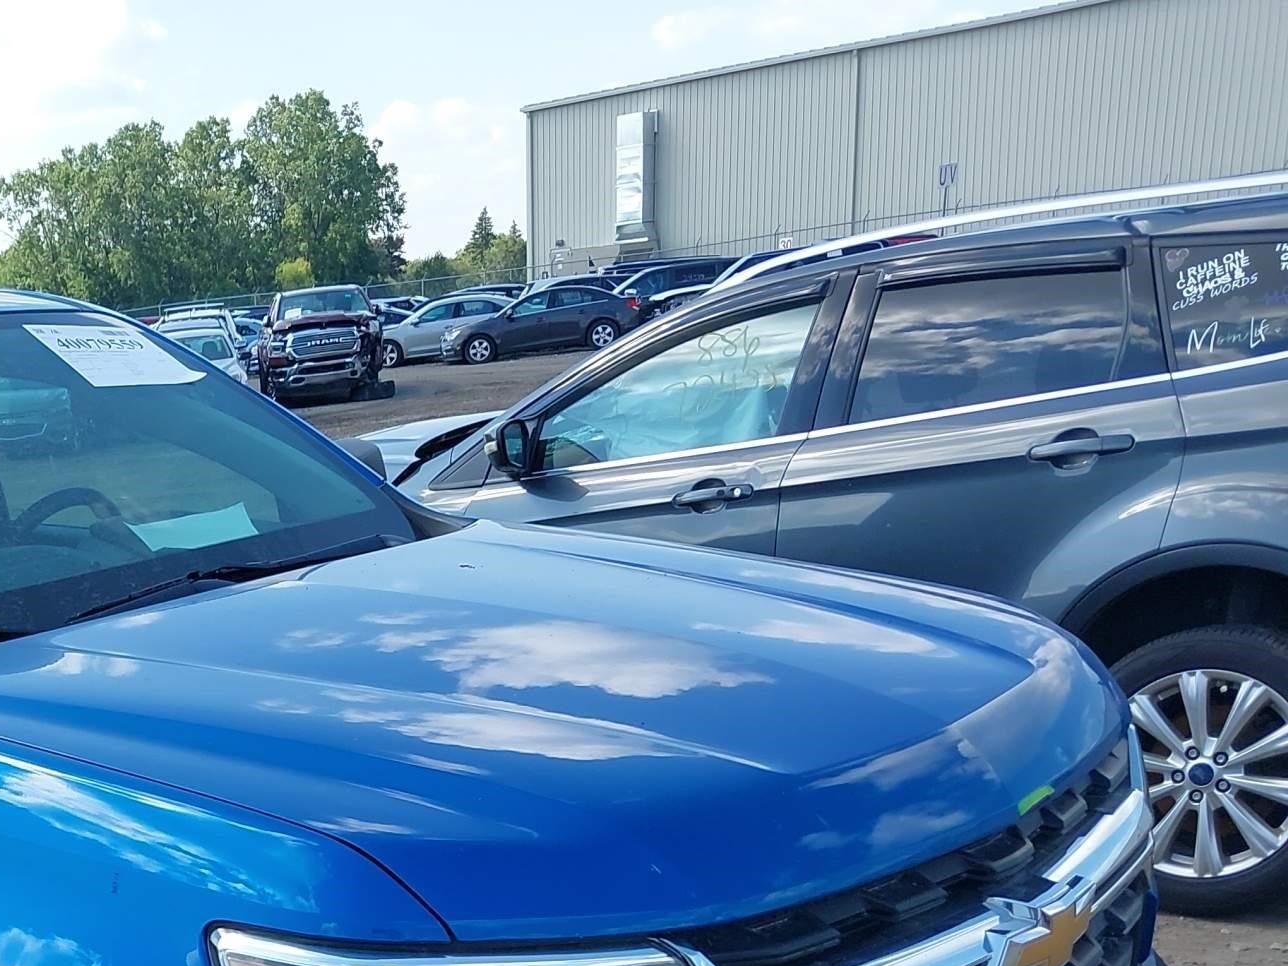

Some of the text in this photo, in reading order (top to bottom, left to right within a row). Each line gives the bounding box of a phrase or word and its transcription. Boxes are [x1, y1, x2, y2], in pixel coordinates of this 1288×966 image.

[1176, 256, 1250, 289] CAFFEINE
[1187, 258, 1218, 277] RUN
[1223, 249, 1245, 264] ON
[1172, 294, 1204, 311] CUSS
[1210, 272, 1258, 298] WORDS
[1183, 273, 1232, 297] CHAOS
[56, 337, 144, 351] 40079559
